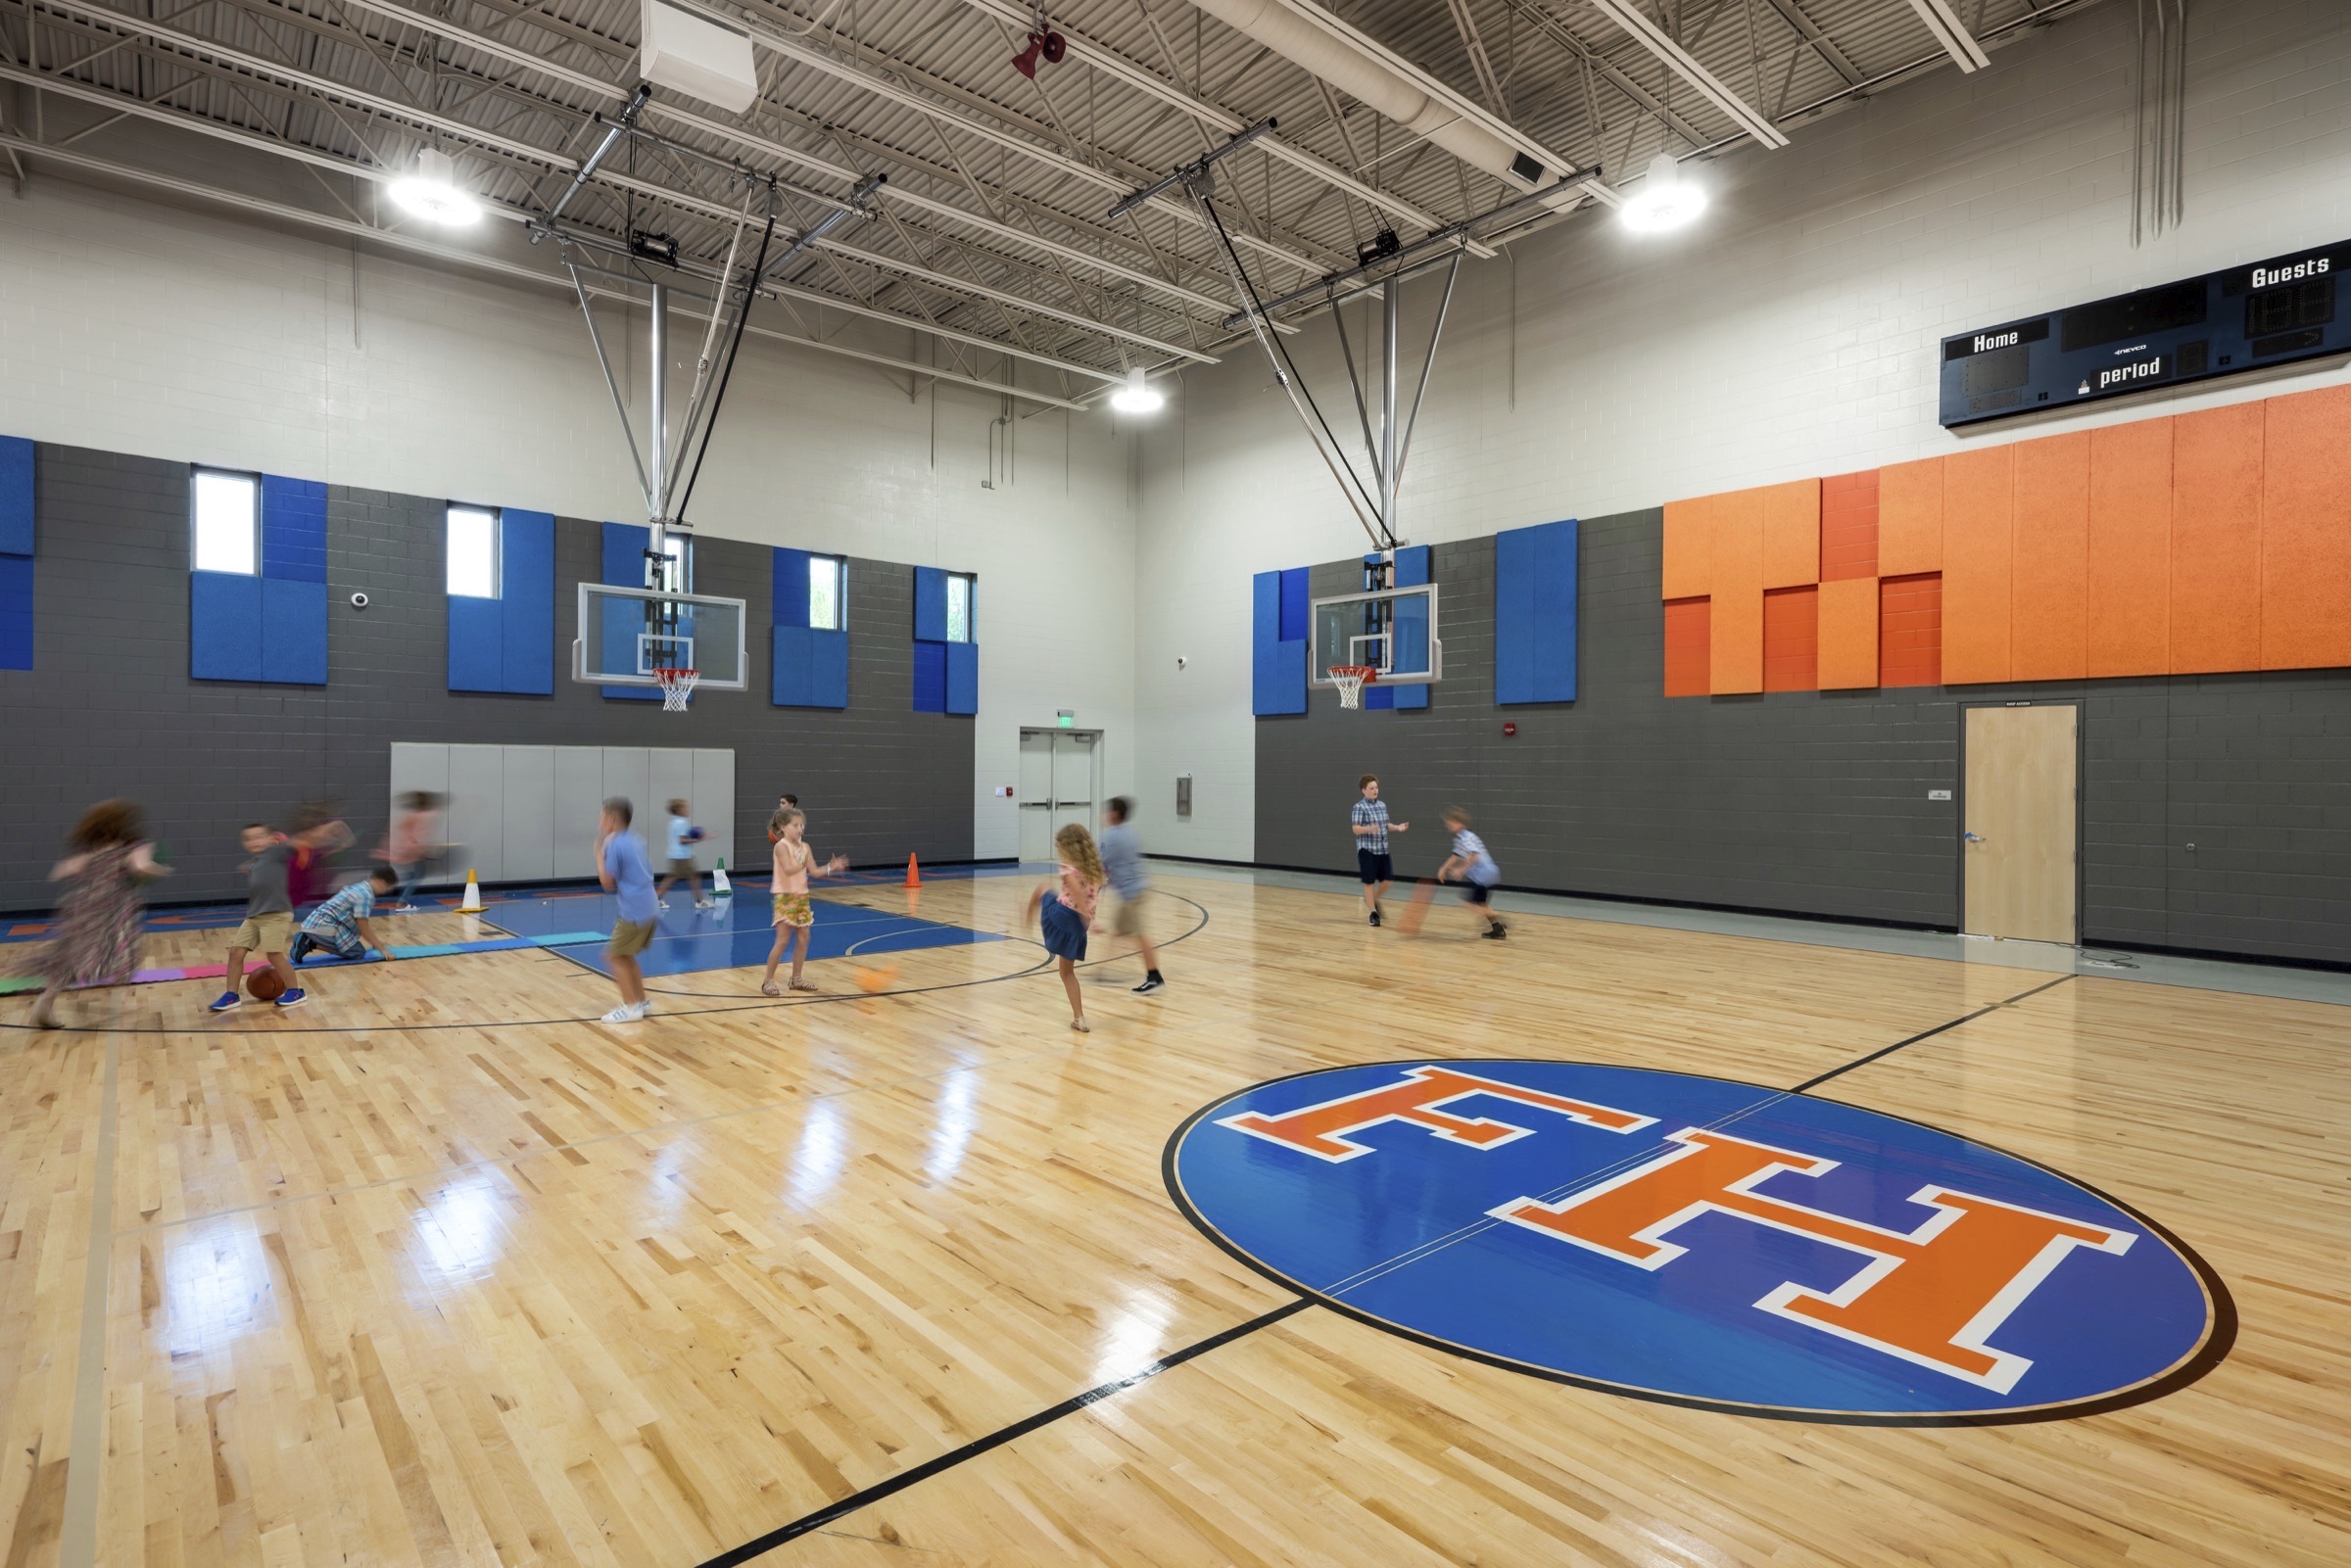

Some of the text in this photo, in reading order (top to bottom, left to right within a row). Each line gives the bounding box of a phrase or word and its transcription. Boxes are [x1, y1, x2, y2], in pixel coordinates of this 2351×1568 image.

[2252, 258, 2329, 288] Guests
[1974, 332, 2018, 354] Home
[2100, 356, 2160, 389] period
